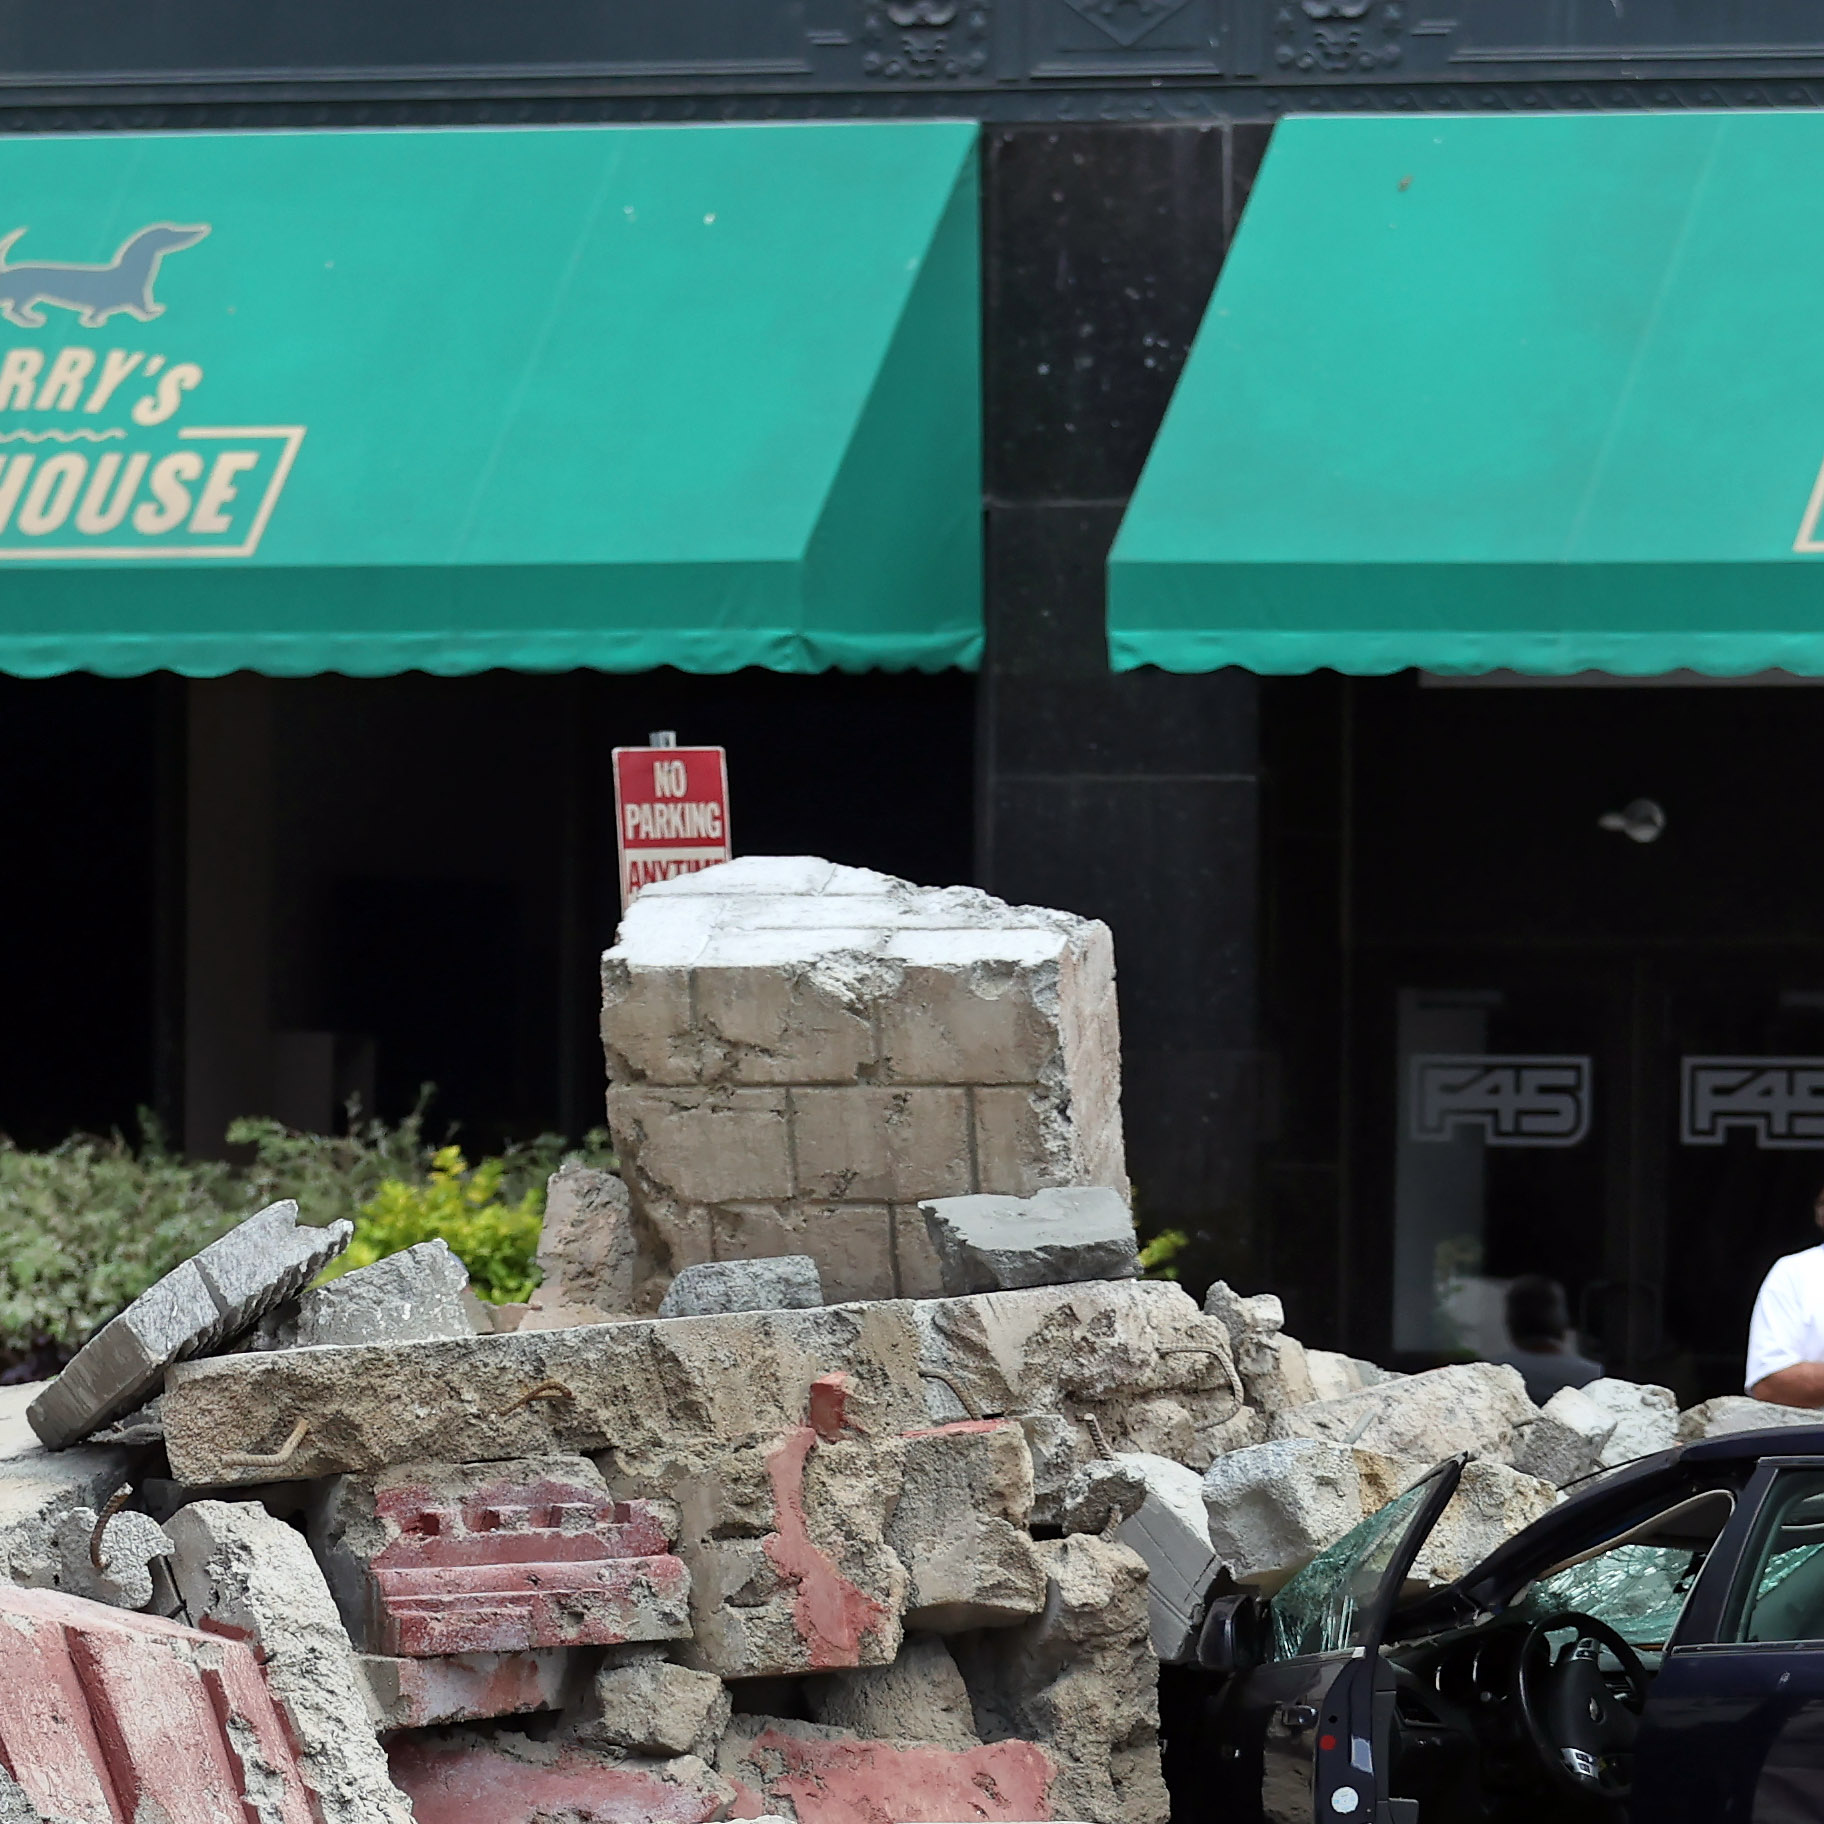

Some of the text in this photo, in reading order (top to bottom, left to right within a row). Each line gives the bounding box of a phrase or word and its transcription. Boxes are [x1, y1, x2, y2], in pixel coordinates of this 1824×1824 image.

[653, 760, 688, 798] NO
[625, 802, 722, 840] PARKING
[1425, 1067, 1577, 1134] F45
